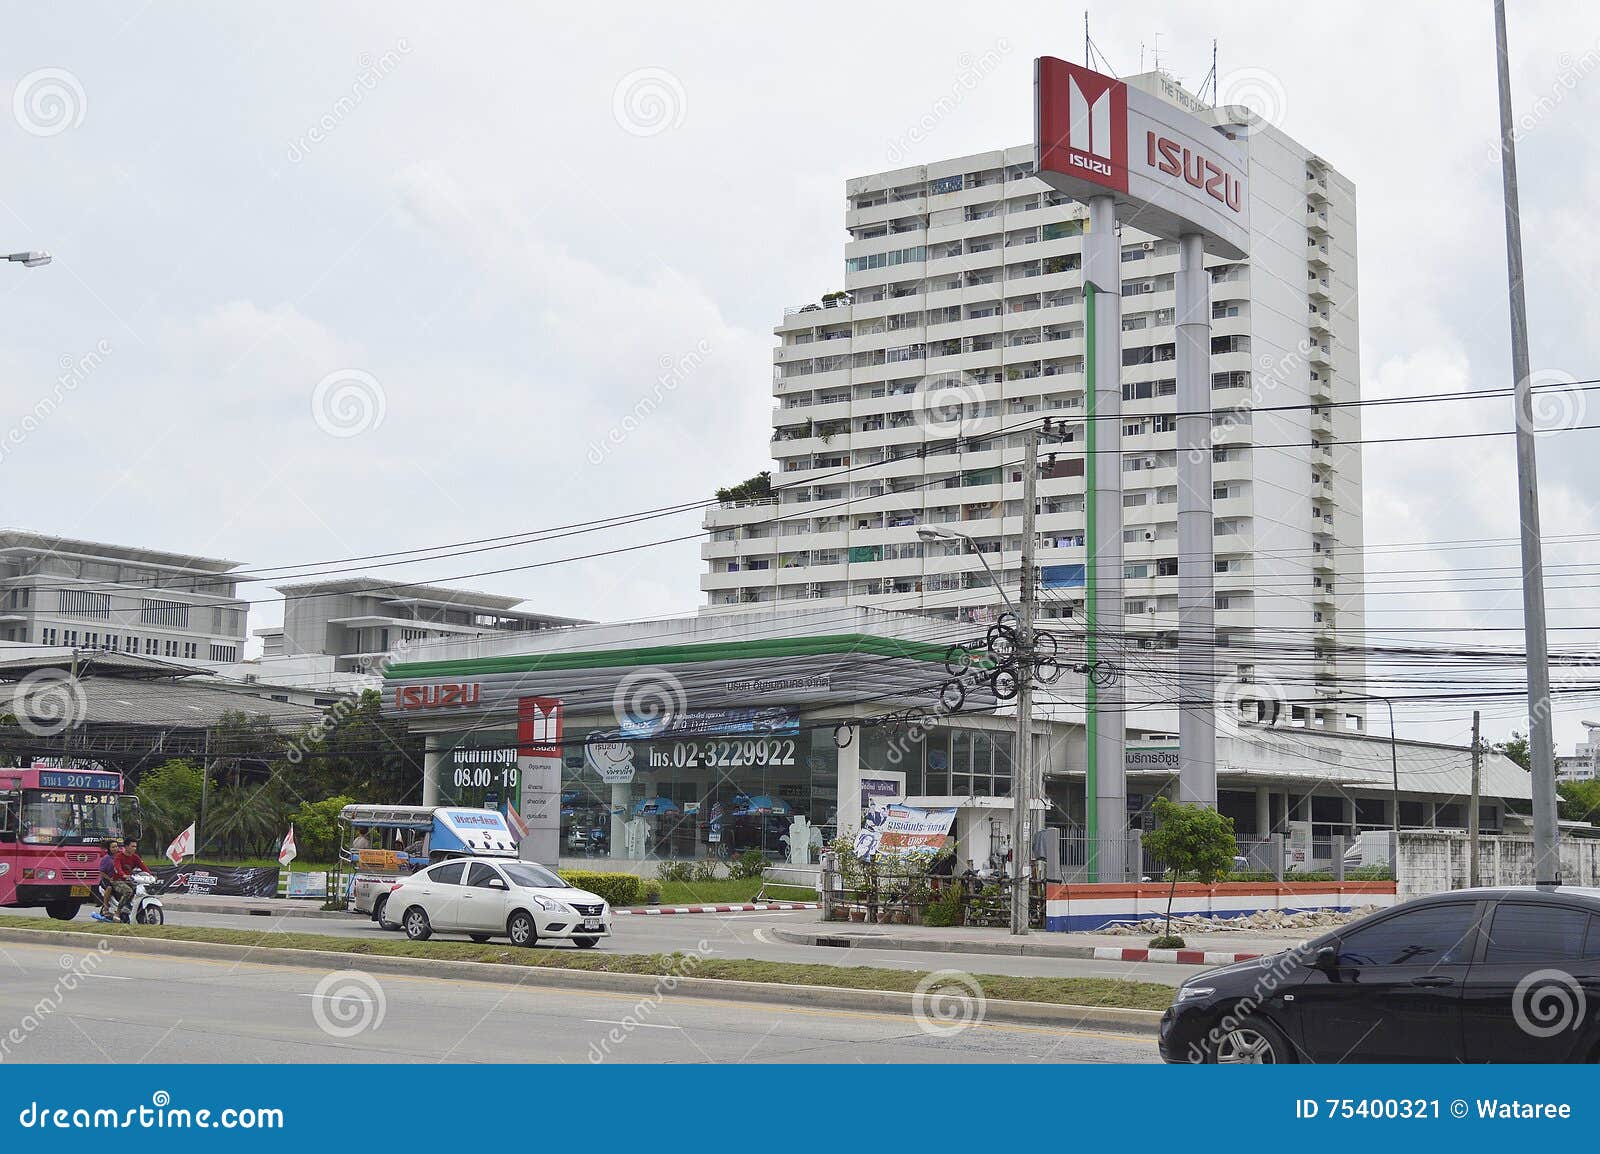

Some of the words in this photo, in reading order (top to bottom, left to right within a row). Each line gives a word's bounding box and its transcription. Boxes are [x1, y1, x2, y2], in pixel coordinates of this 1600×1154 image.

[1161, 79, 1173, 97] THE
[1070, 153, 1112, 177] ISUZU
[1147, 130, 1241, 213] ISUZU
[395, 683, 480, 710] ISUZU
[1125, 751, 1179, 766] บริการอีซูซุ
[67, 775, 92, 787] 207
[453, 768, 492, 787] 08.00
[482, 831, 492, 841] 5
